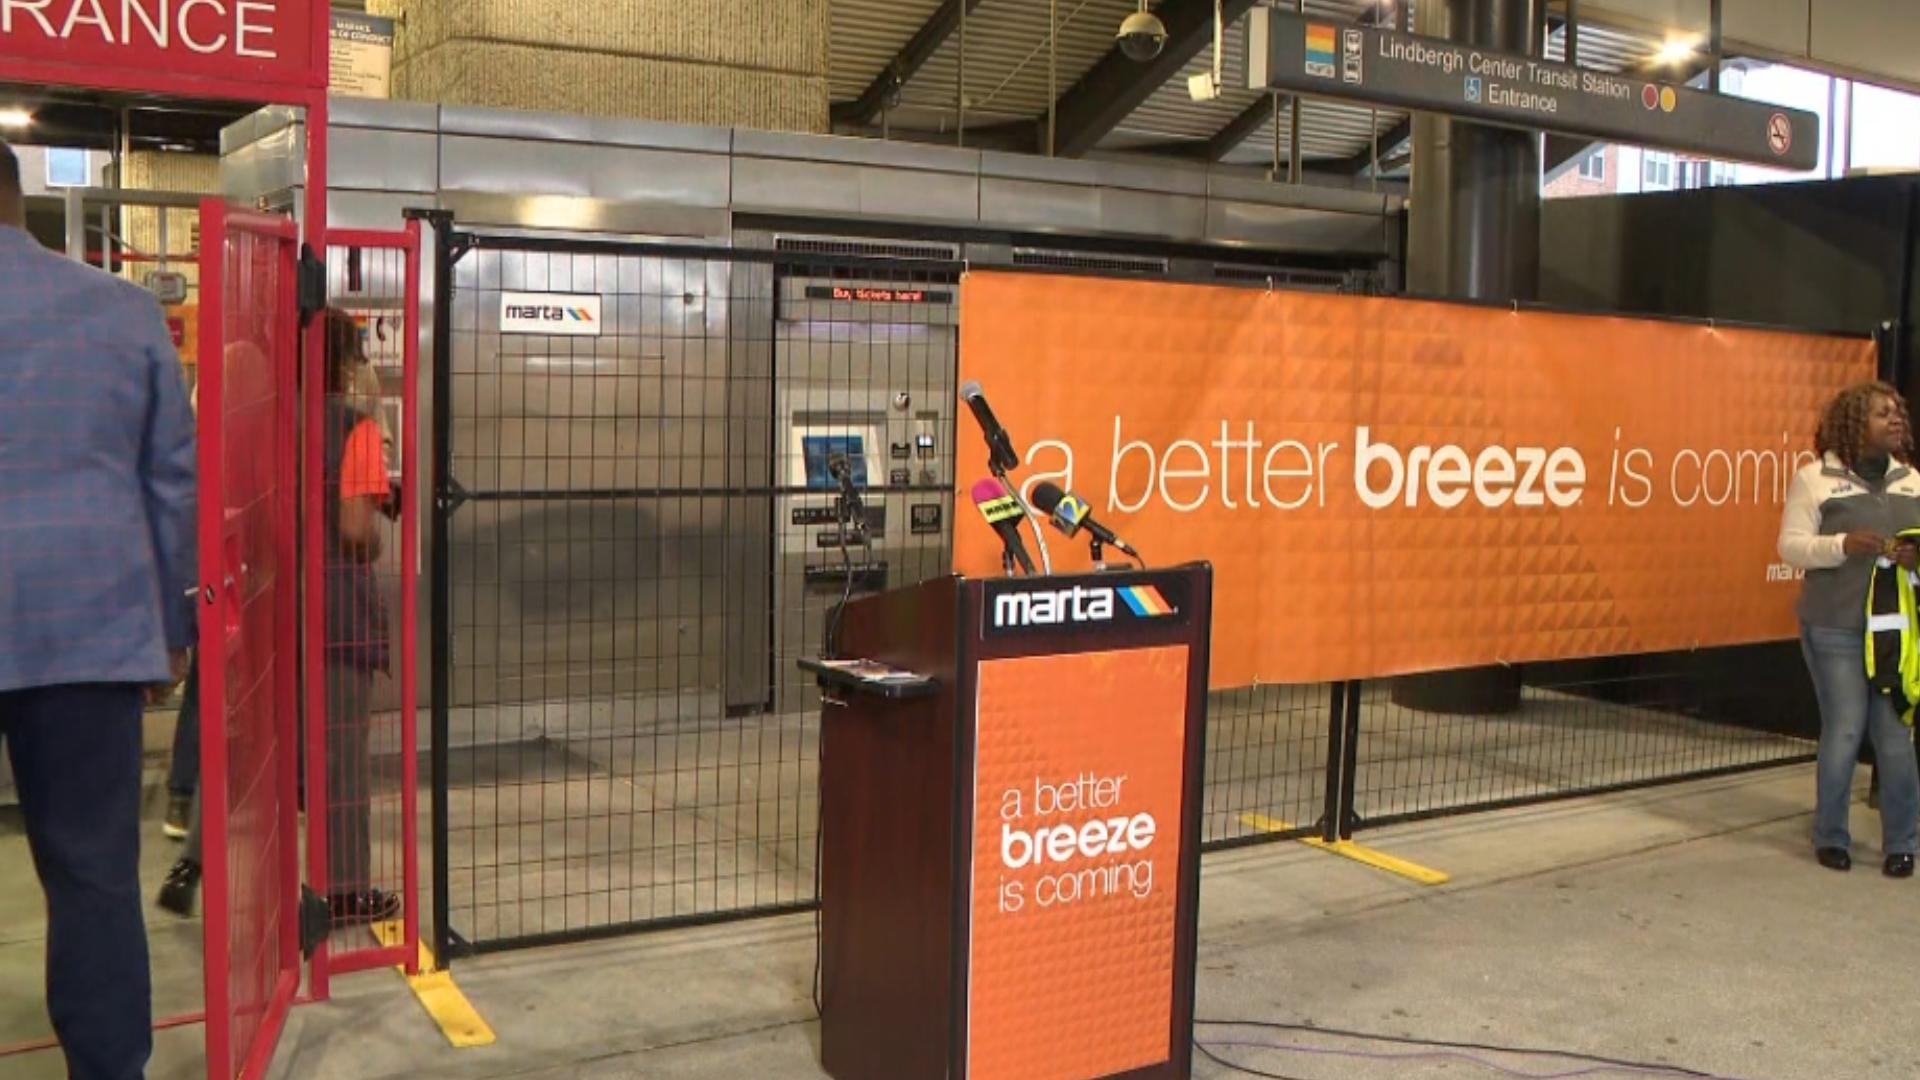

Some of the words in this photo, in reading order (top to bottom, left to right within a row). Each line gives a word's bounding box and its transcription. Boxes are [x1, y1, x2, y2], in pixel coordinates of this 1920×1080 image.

[1379, 36, 1463, 73] Lindbergh
[1468, 52, 1522, 80] Center
[1527, 63, 1578, 90] Transit
[1582, 70, 1630, 100] Station
[1488, 84, 1557, 112] Entrance
[506, 304, 563, 321] marta
[1020, 440, 1074, 515] a
[1108, 415, 1338, 513] better
[1354, 425, 1586, 509] breeze
[1608, 426, 1653, 508] is
[995, 585, 1114, 627] marta
[1000, 788, 1022, 820] a
[1035, 771, 1128, 816] better
[1002, 812, 1156, 869] breeze
[999, 875, 1025, 913] is
[1035, 857, 1153, 908] coming
